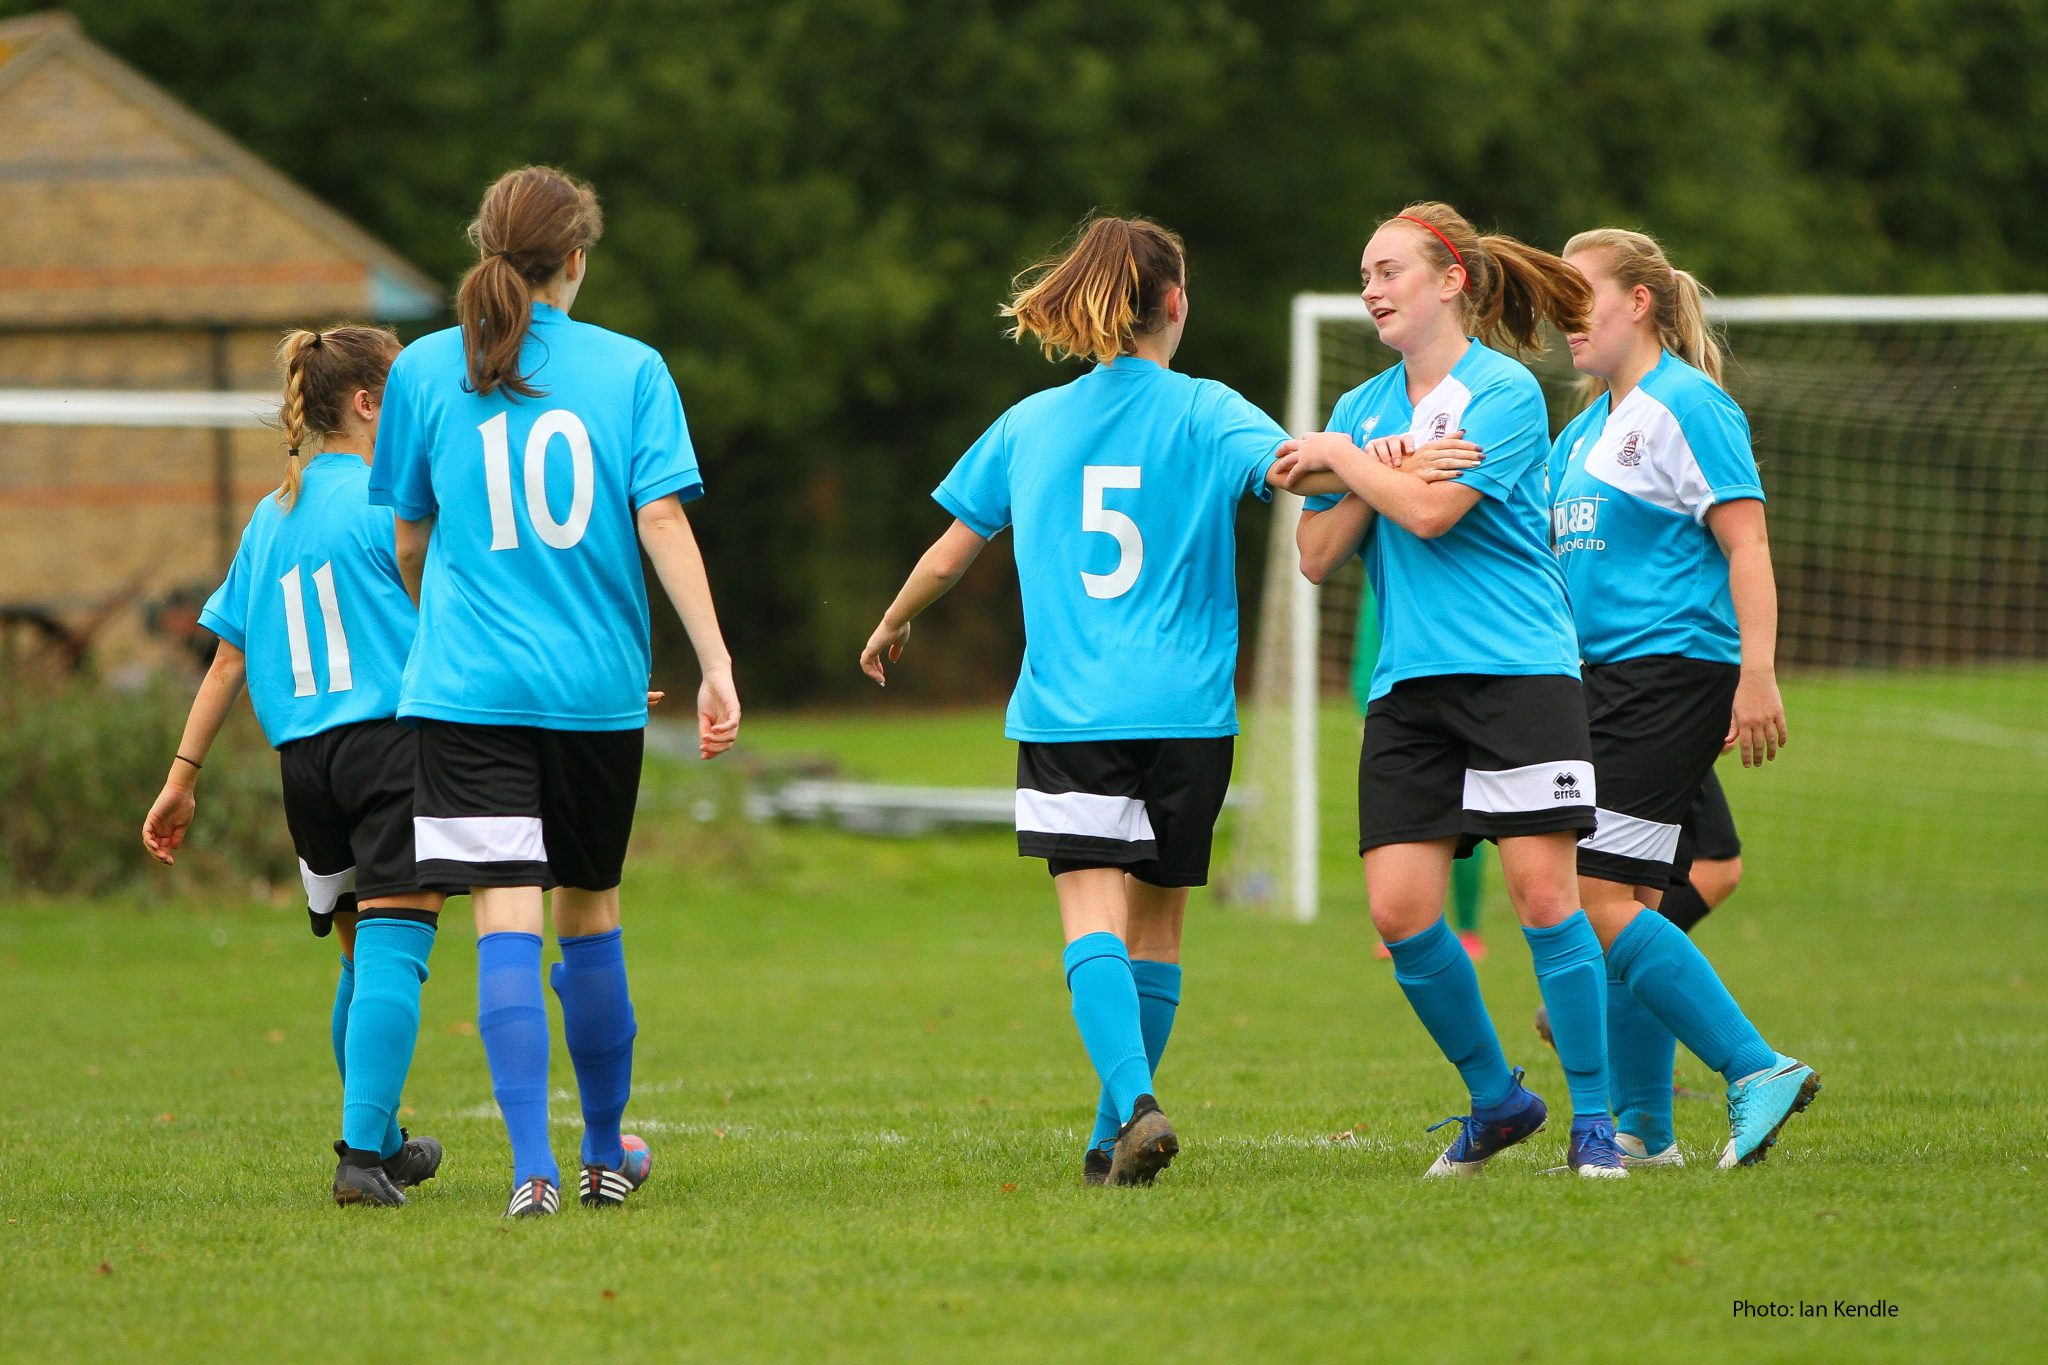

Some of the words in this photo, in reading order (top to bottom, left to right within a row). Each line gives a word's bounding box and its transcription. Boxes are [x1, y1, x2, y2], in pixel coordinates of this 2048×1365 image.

[478, 409, 595, 551] 10
[1080, 466, 1144, 600] 5
[1586, 539, 1606, 551] LTD
[280, 561, 353, 698] 11
